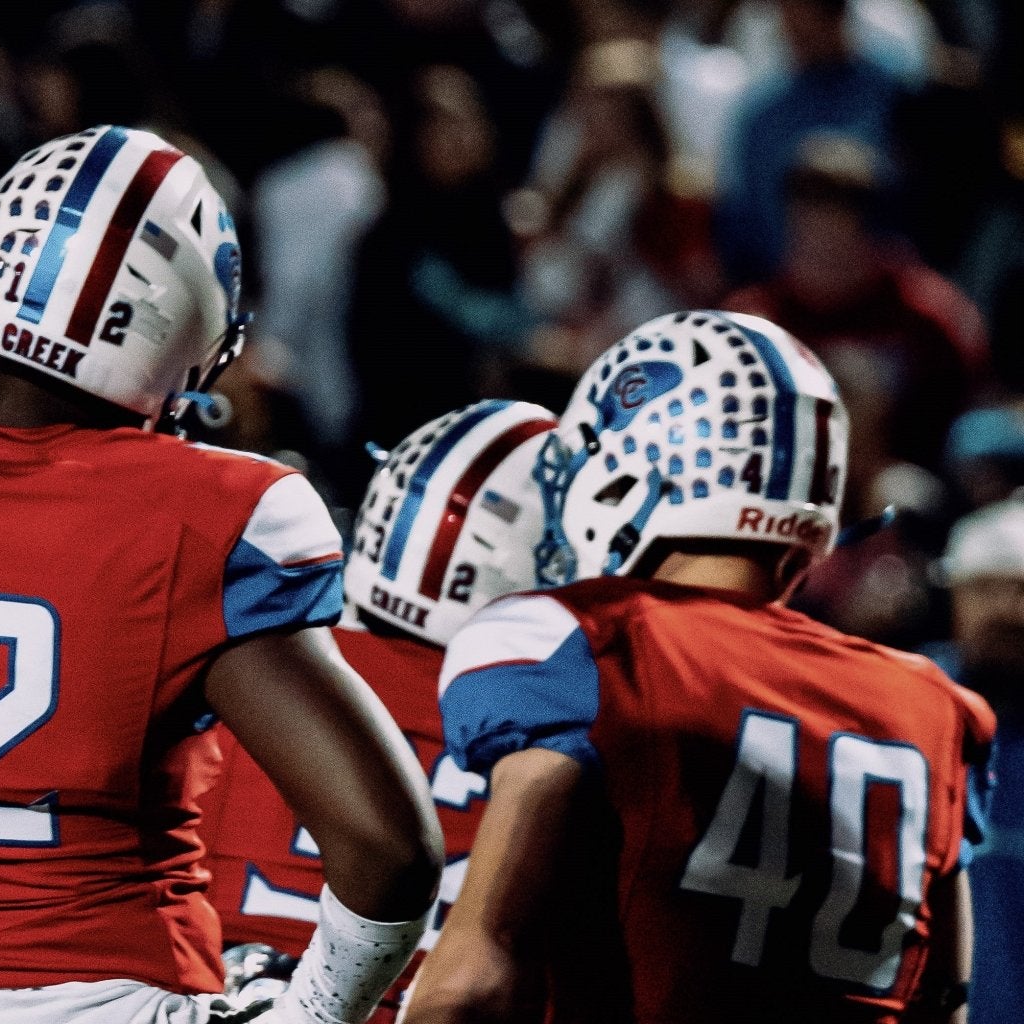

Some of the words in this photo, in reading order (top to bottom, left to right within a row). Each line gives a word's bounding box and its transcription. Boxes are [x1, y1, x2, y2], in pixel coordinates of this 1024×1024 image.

[5, 262, 25, 302] 1
[99, 301, 133, 346] 2
[2, 323, 86, 378] CREEK
[739, 452, 764, 495] 4
[448, 562, 478, 603] 2
[679, 706, 930, 996] 40
